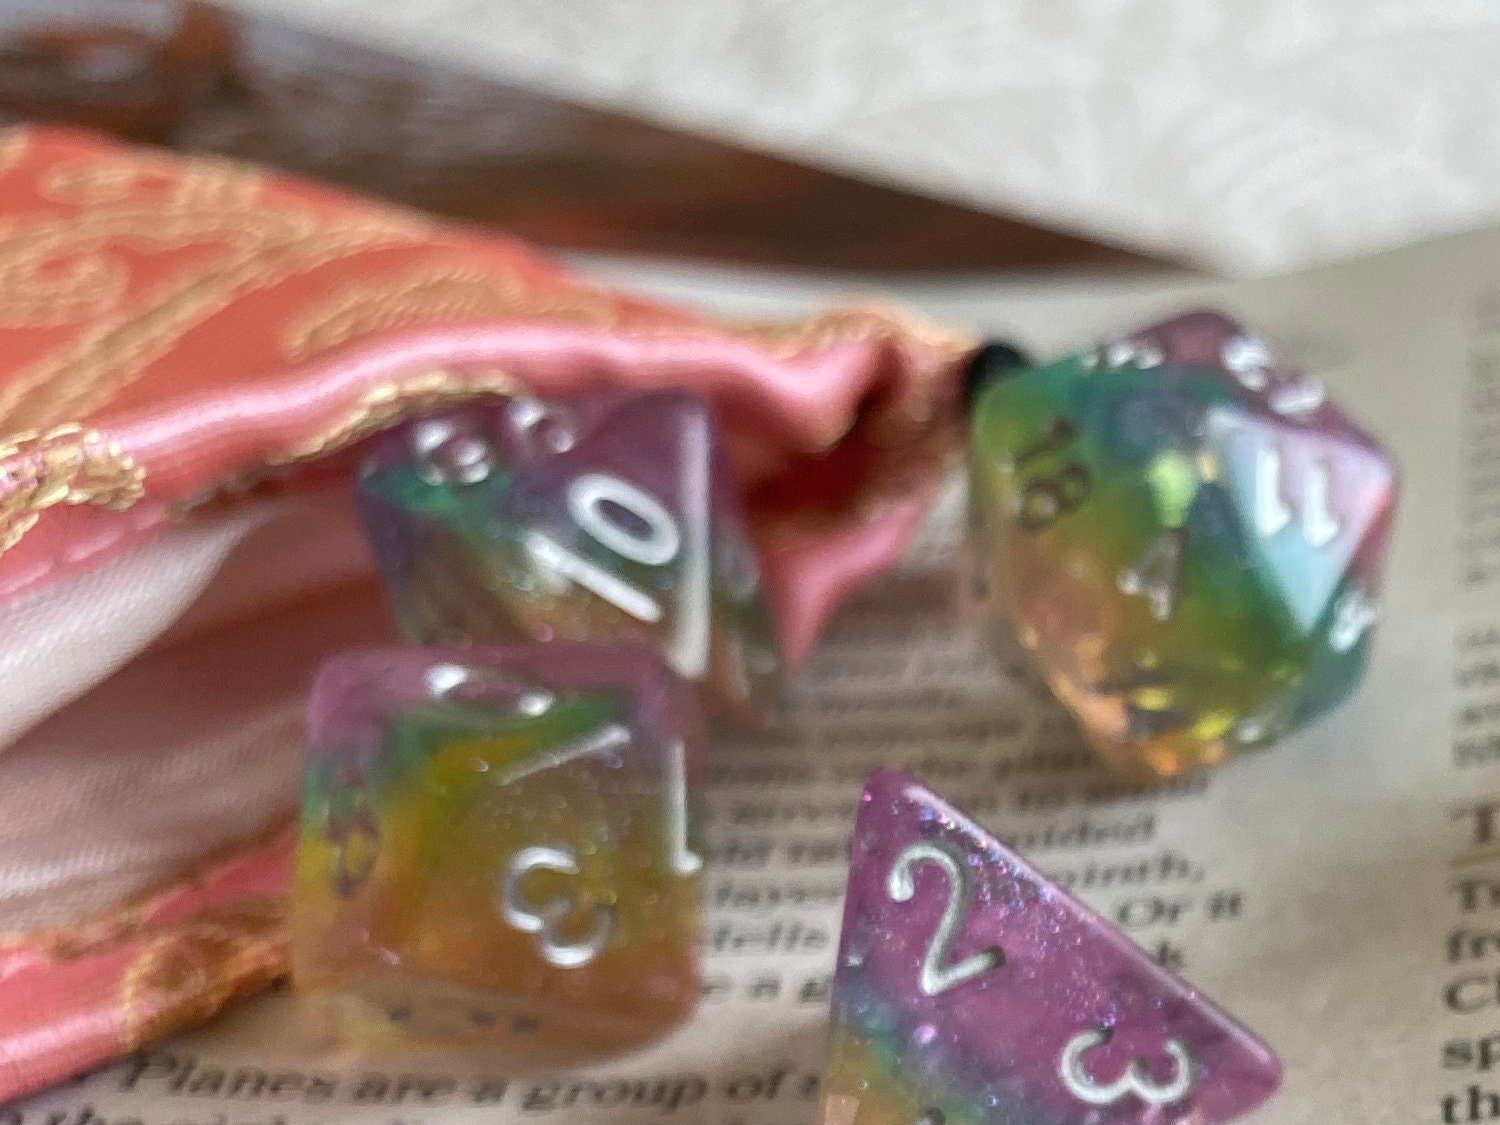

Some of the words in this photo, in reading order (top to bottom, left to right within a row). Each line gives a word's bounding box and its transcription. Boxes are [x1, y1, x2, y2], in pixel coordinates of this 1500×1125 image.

[887, 838, 1005, 998] 2
[118, 1048, 338, 1102] Planes
[518, 1073, 708, 1116] group
[724, 1062, 797, 1099] of
[1058, 1022, 1198, 1106] 3
